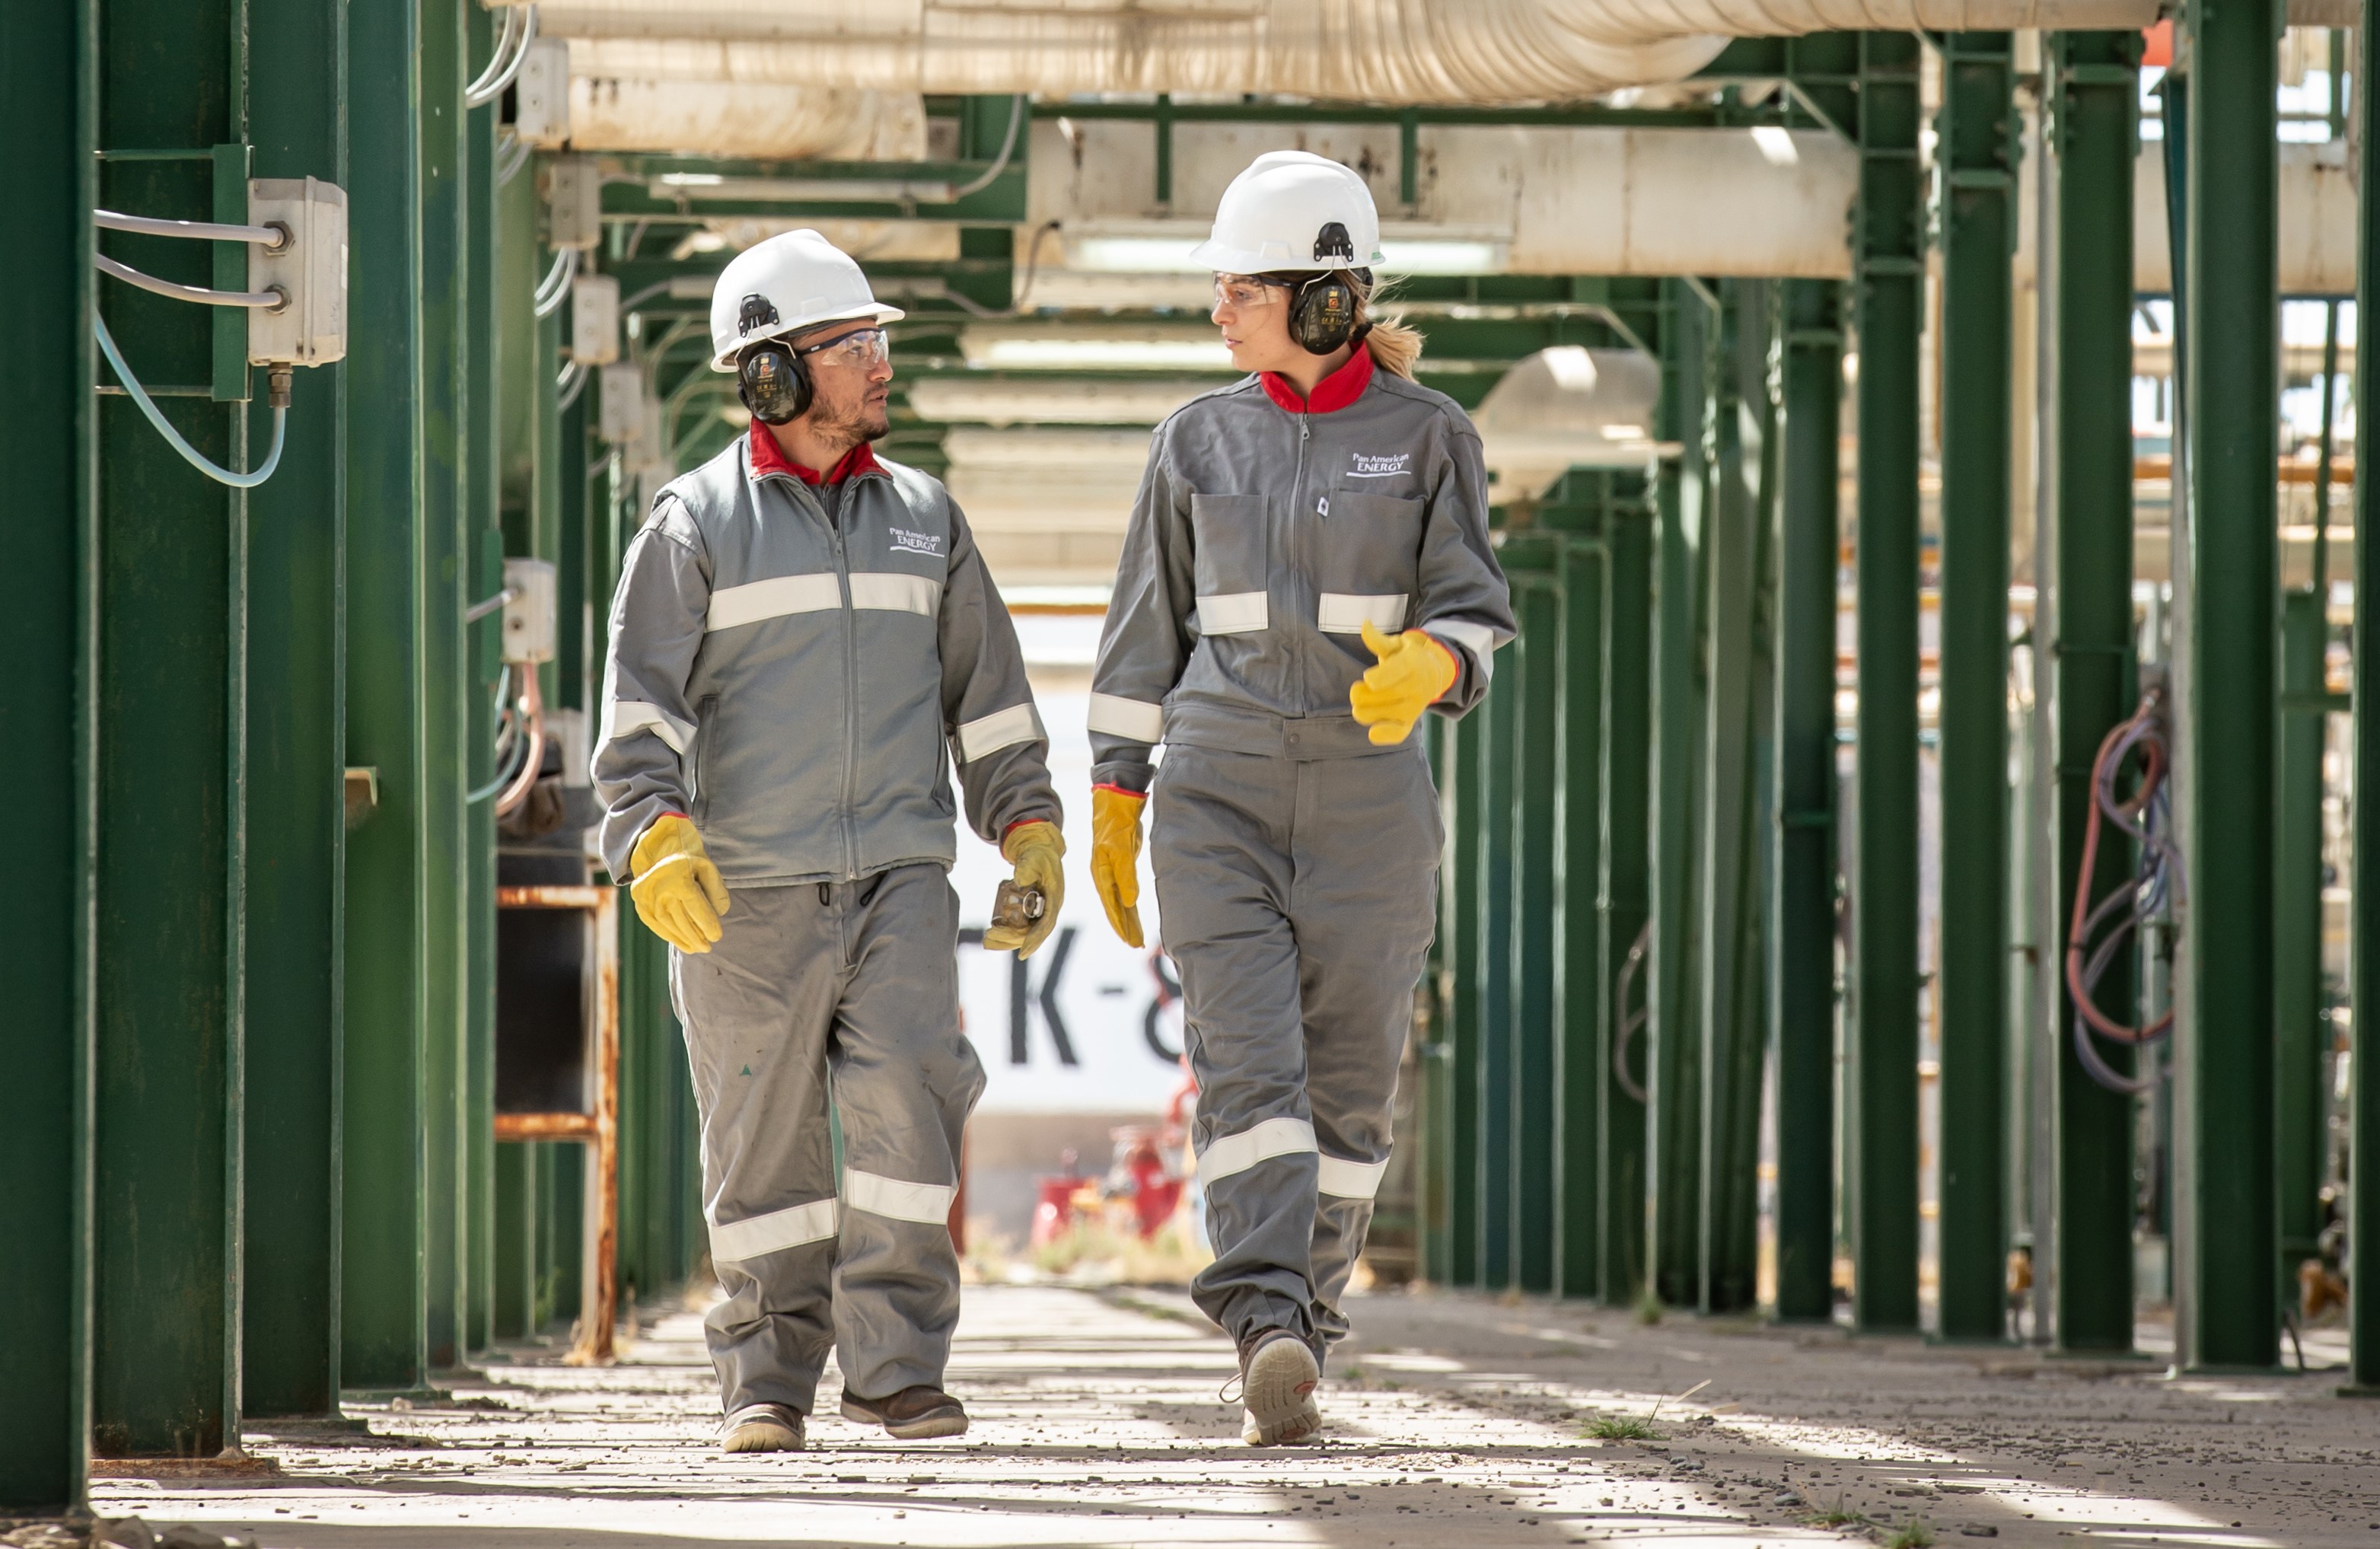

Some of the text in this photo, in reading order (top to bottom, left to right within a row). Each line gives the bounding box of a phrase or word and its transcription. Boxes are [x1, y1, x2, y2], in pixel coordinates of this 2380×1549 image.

[1352, 453, 1409, 463] Pan American
[1357, 461, 1403, 472] ENERGY
[889, 527, 940, 542] Pan American
[897, 535, 936, 551] ENERGY
